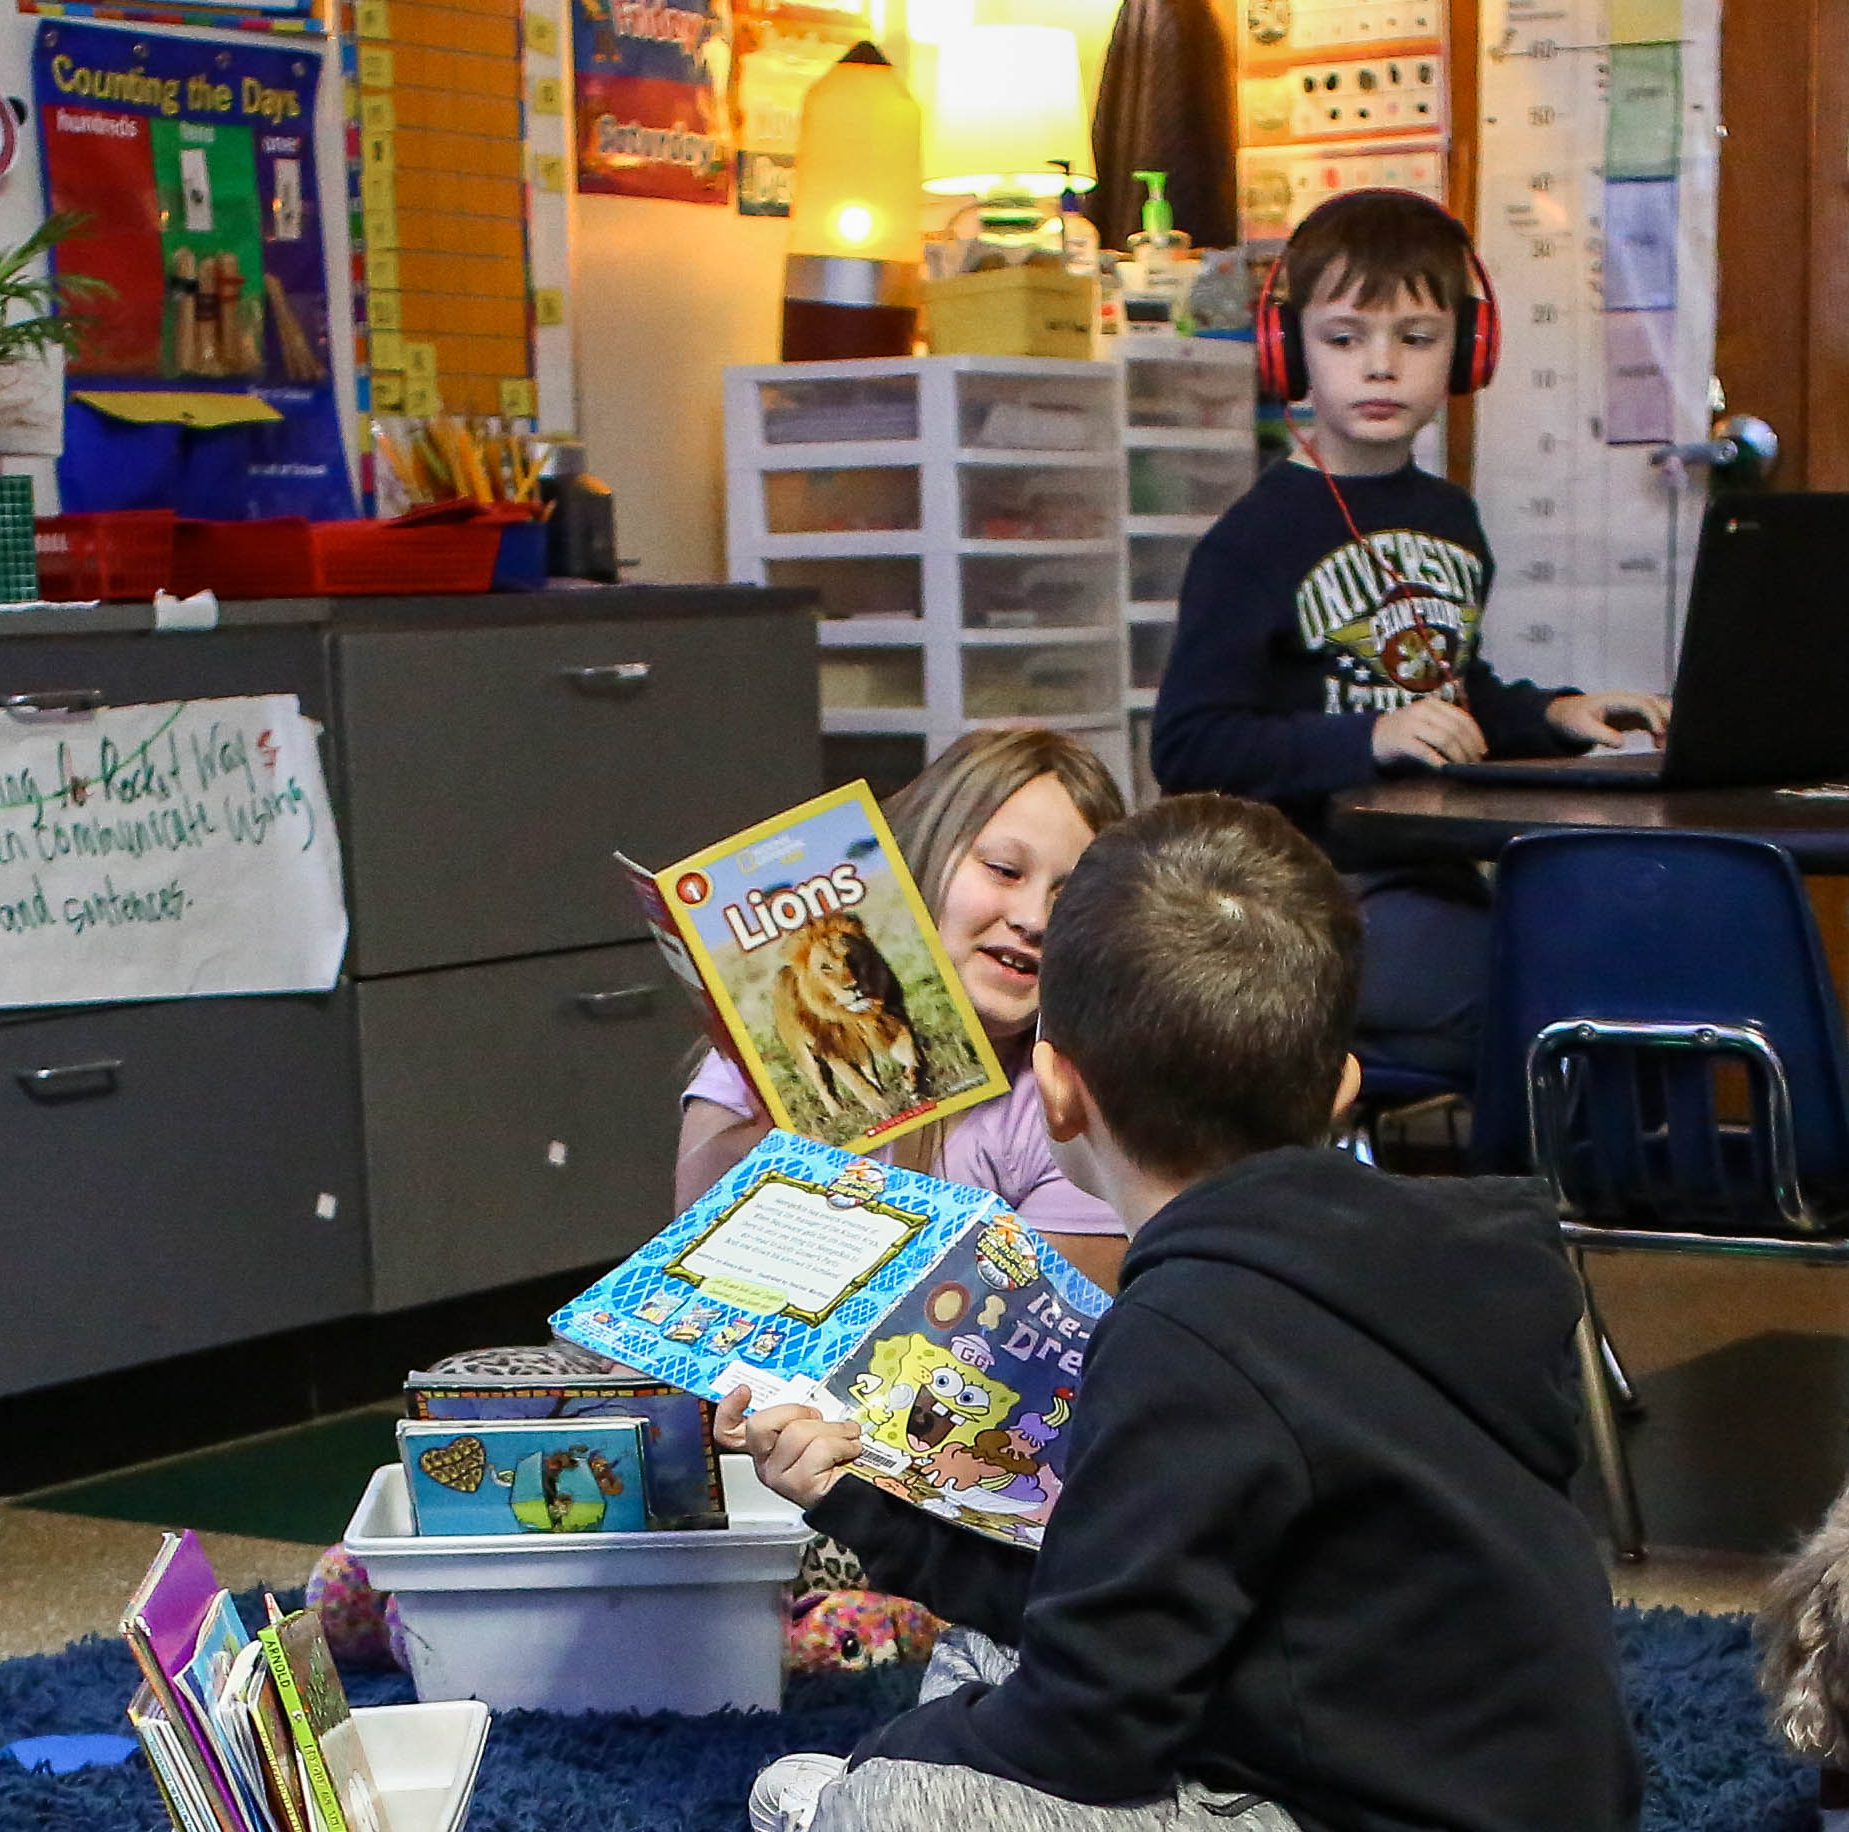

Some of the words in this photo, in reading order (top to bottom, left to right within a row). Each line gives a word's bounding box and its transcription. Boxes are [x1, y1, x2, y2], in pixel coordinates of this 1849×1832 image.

[52, 54, 180, 116] Counting
[186, 73, 233, 112] the
[241, 76, 301, 125] Days
[1296, 531, 1485, 650] UNIVERSITY
[723, 864, 866, 953] Lions
[265, 1639, 291, 1689] ARNOLD
